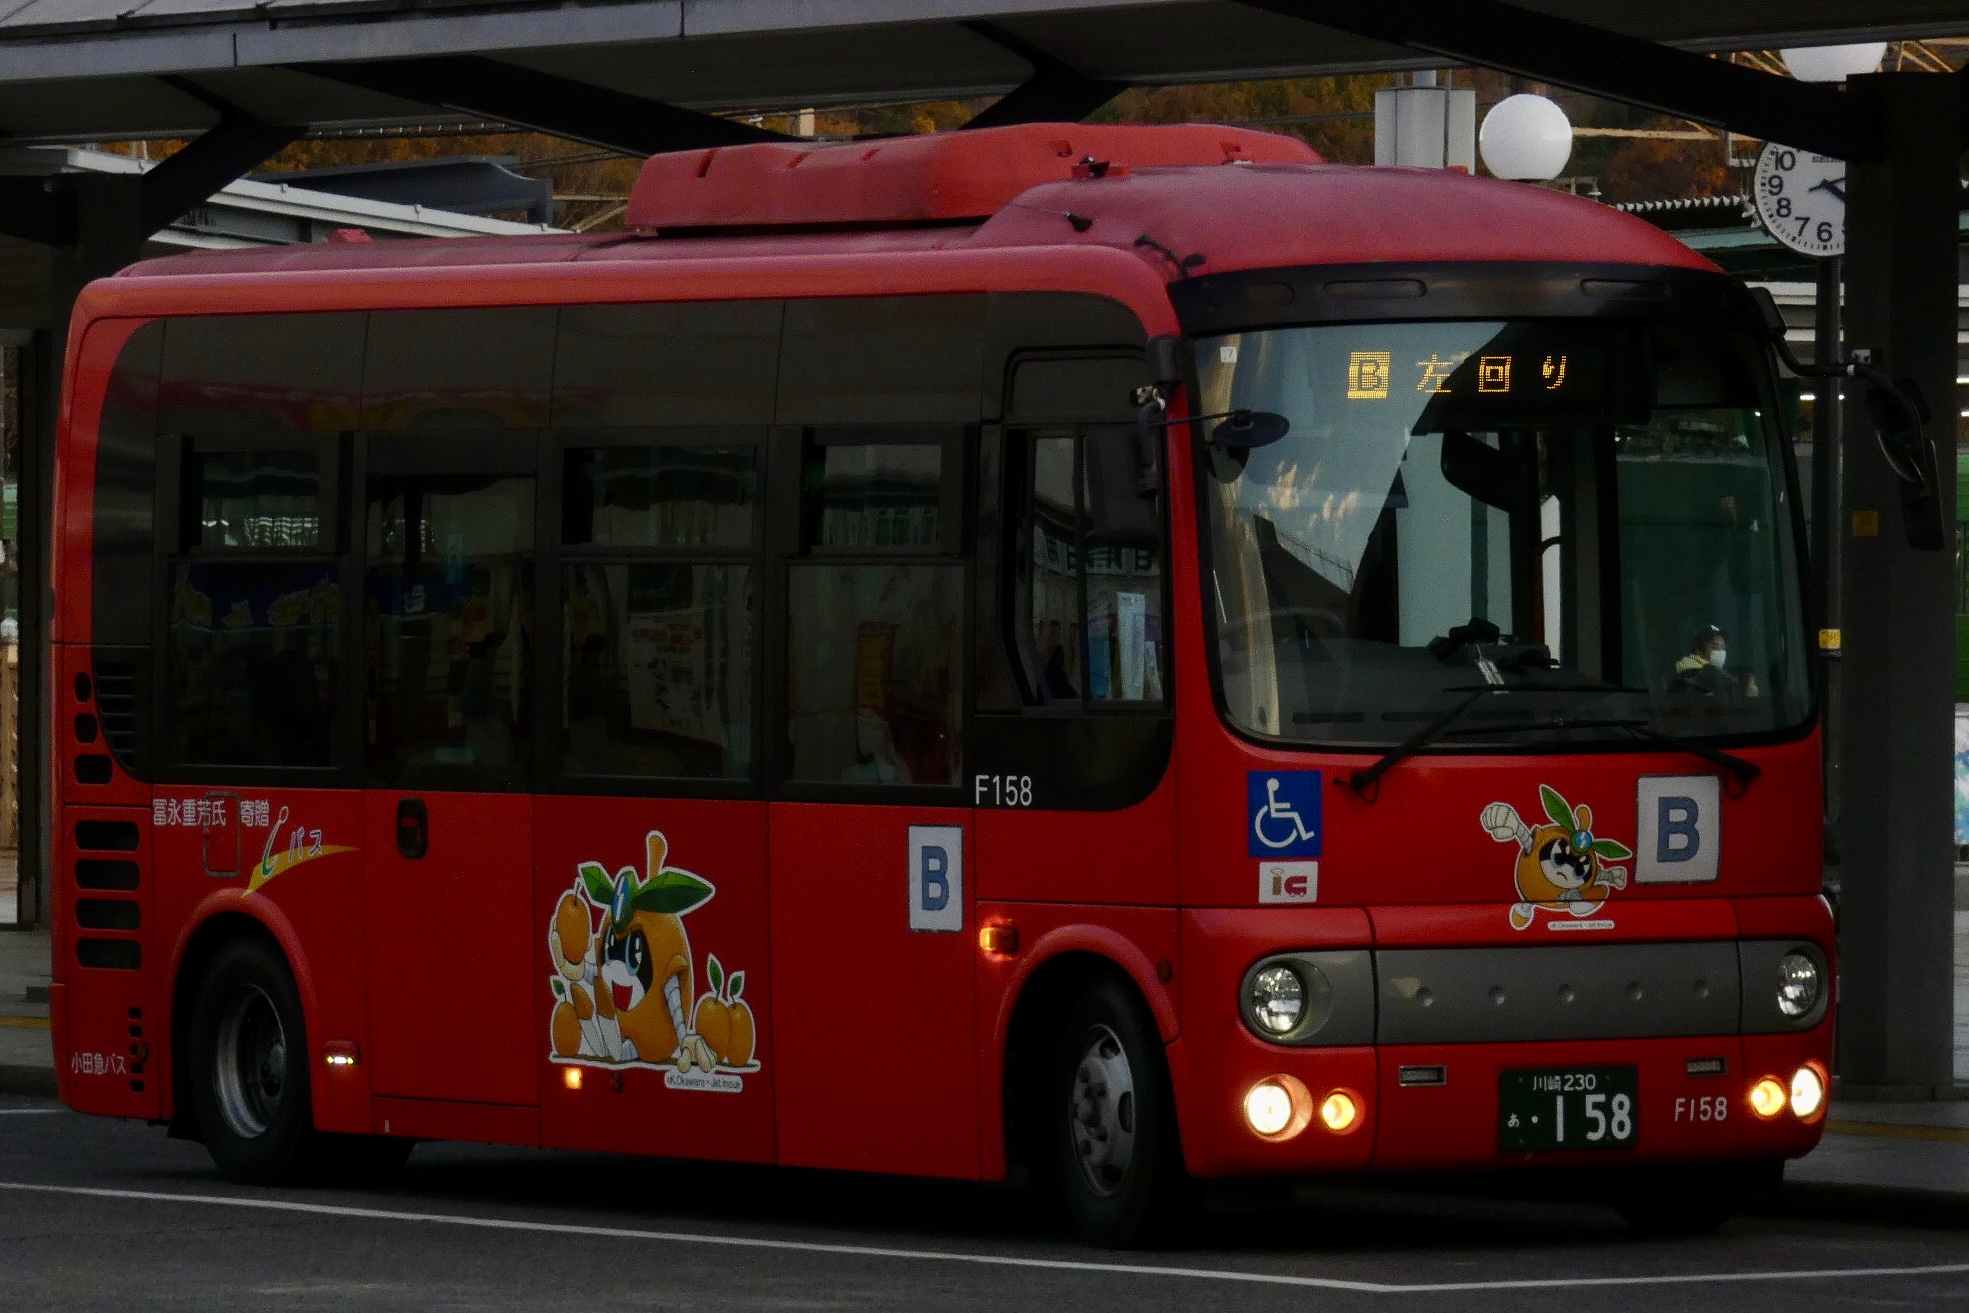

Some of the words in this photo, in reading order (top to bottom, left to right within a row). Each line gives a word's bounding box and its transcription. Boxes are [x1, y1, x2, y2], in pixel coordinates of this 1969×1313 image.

[1774, 150, 1796, 171] 10
[1767, 174, 1784, 196] 9
[1776, 197, 1792, 218] 8
[1795, 216, 1811, 237] 7
[1816, 222, 1833, 243] 6
[975, 774, 1033, 806] F158
[1657, 796, 1700, 863] B
[921, 845, 950, 911] B
[70, 1051, 127, 1075] 小田急バス
[1674, 1095, 1728, 1122] F158
[1507, 1112, 1520, 1128] あ
